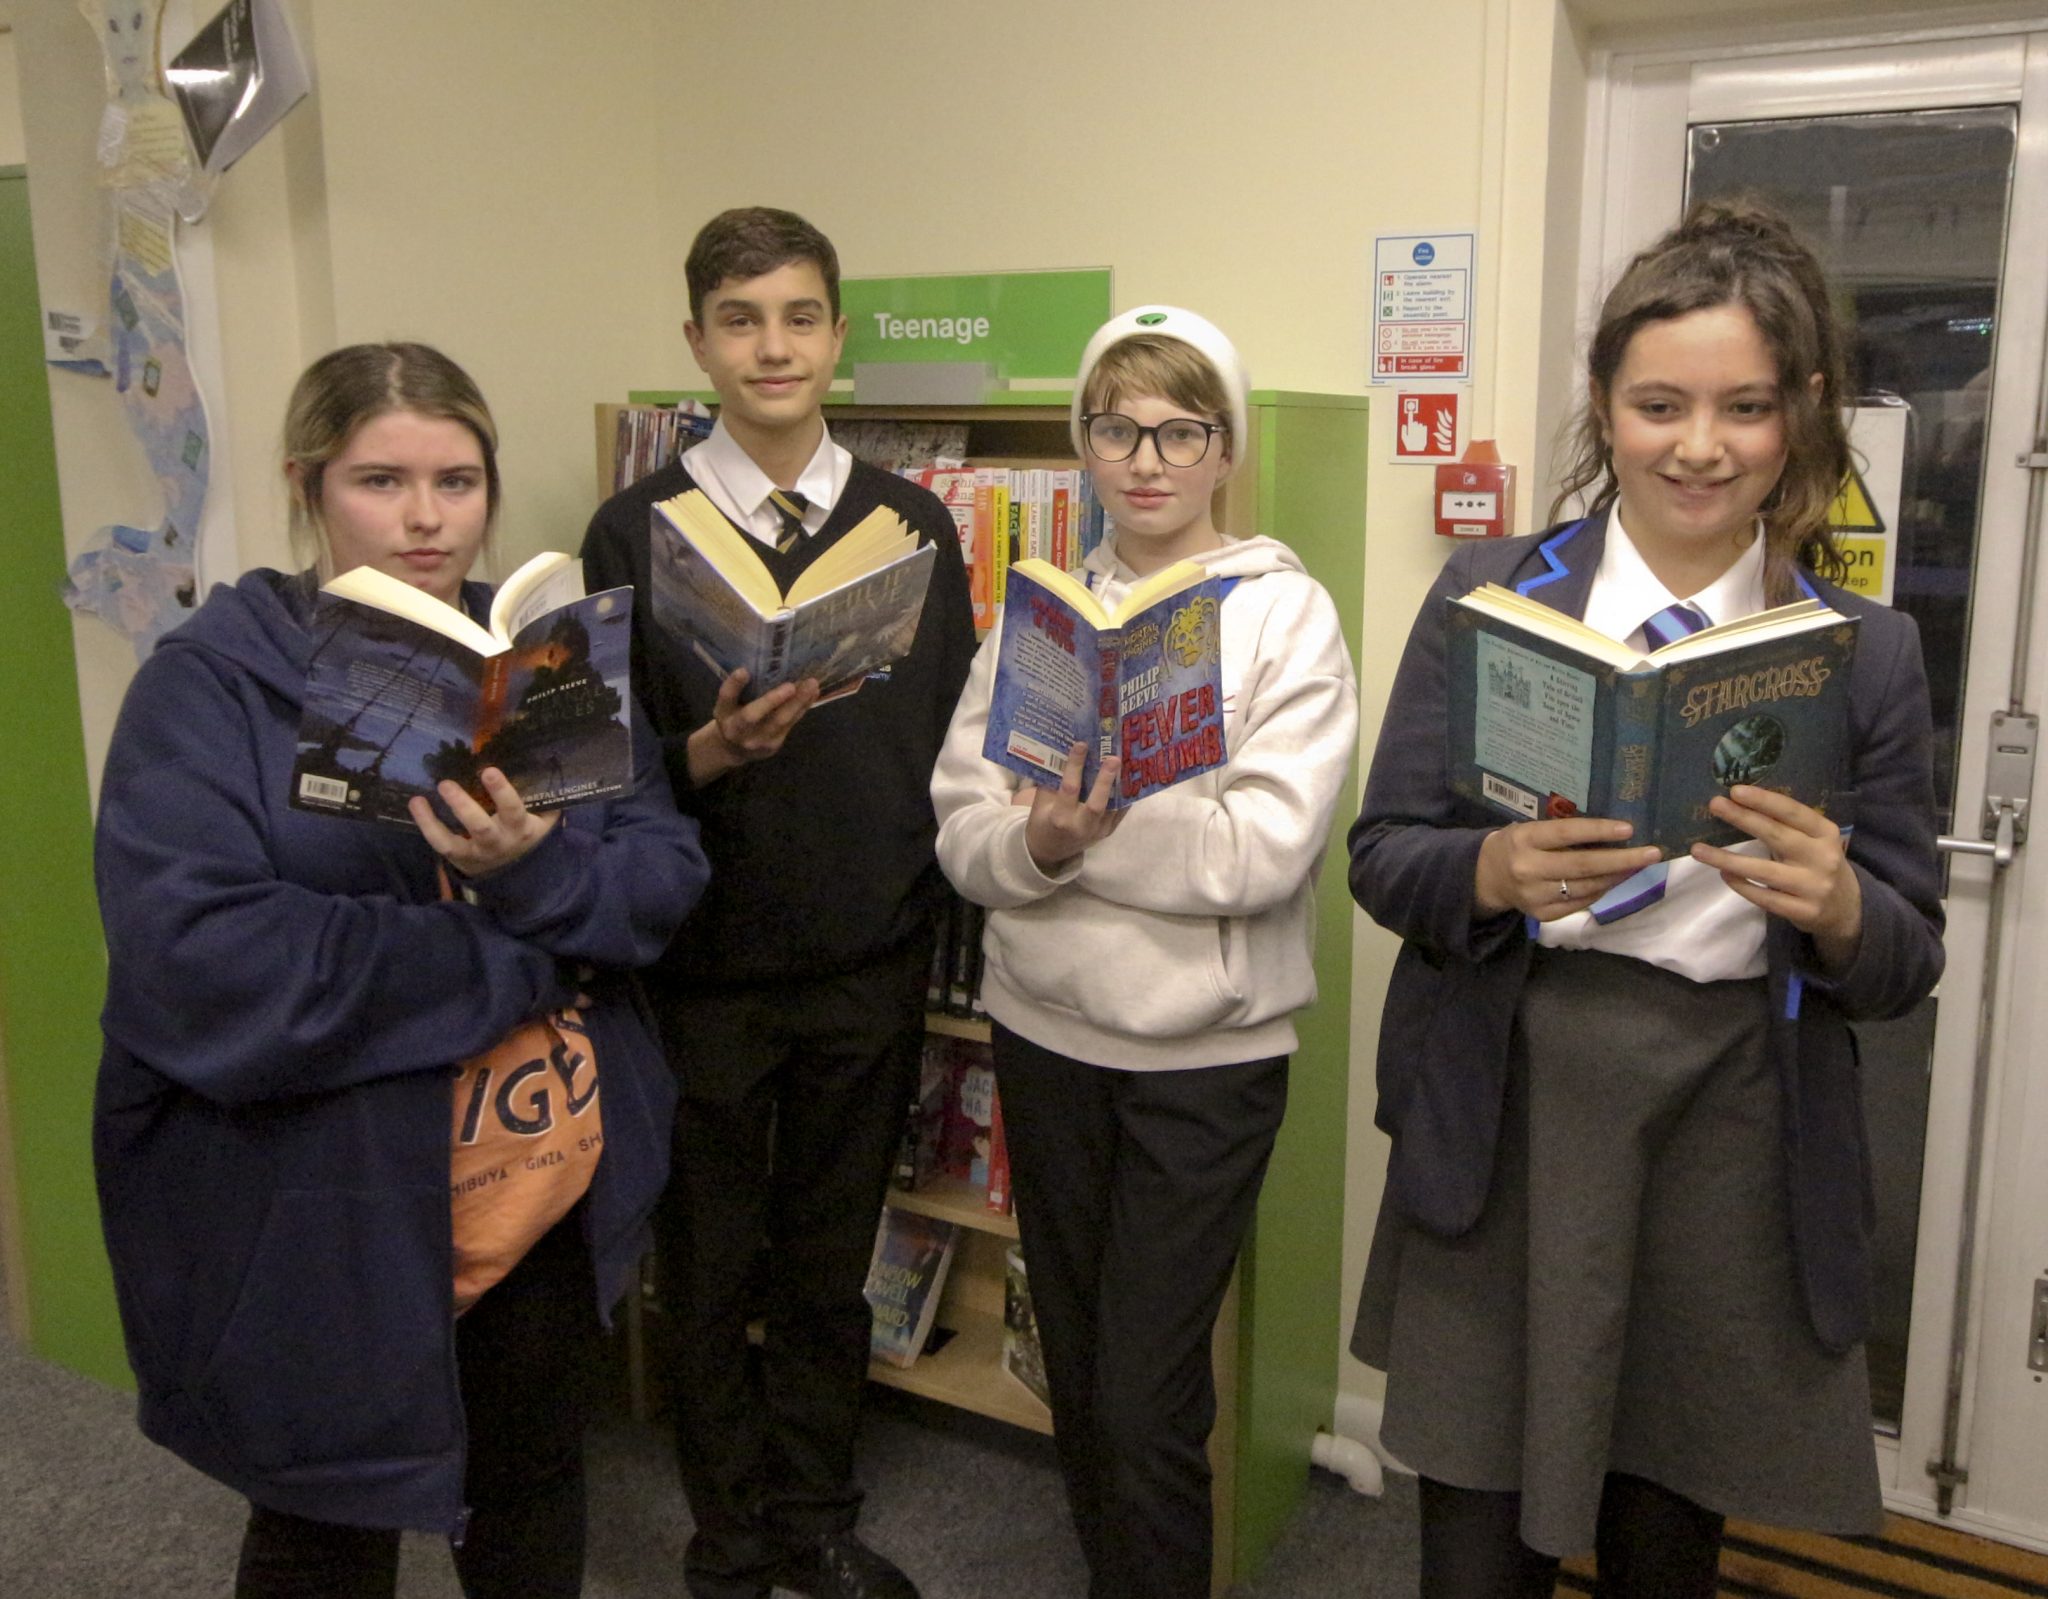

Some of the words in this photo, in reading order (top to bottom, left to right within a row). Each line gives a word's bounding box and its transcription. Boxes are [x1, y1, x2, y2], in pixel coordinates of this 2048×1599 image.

[874, 313, 989, 344] Teenage
[1010, 505, 1018, 536] FACE
[1845, 577, 1868, 588] tep
[526, 687, 556, 704] PHILIP
[560, 678, 588, 691] REEVE
[1120, 666, 1160, 699] PHILIP
[1679, 656, 1831, 729] STARCROSS
[1120, 685, 1160, 717] REEVE
[1121, 684, 1215, 757] FEVER
[1121, 725, 1221, 798] CRUMB
[522, 789, 555, 802] ORTAL
[559, 781, 599, 795] ENGINES
[542, 797, 565, 805] MAJOR
[567, 790, 594, 801] MOTION
[596, 784, 622, 794] PICTURE
[451, 1168, 508, 1196] HIBUYA
[525, 1150, 565, 1170] GINZA
[579, 1132, 601, 1152] SH
